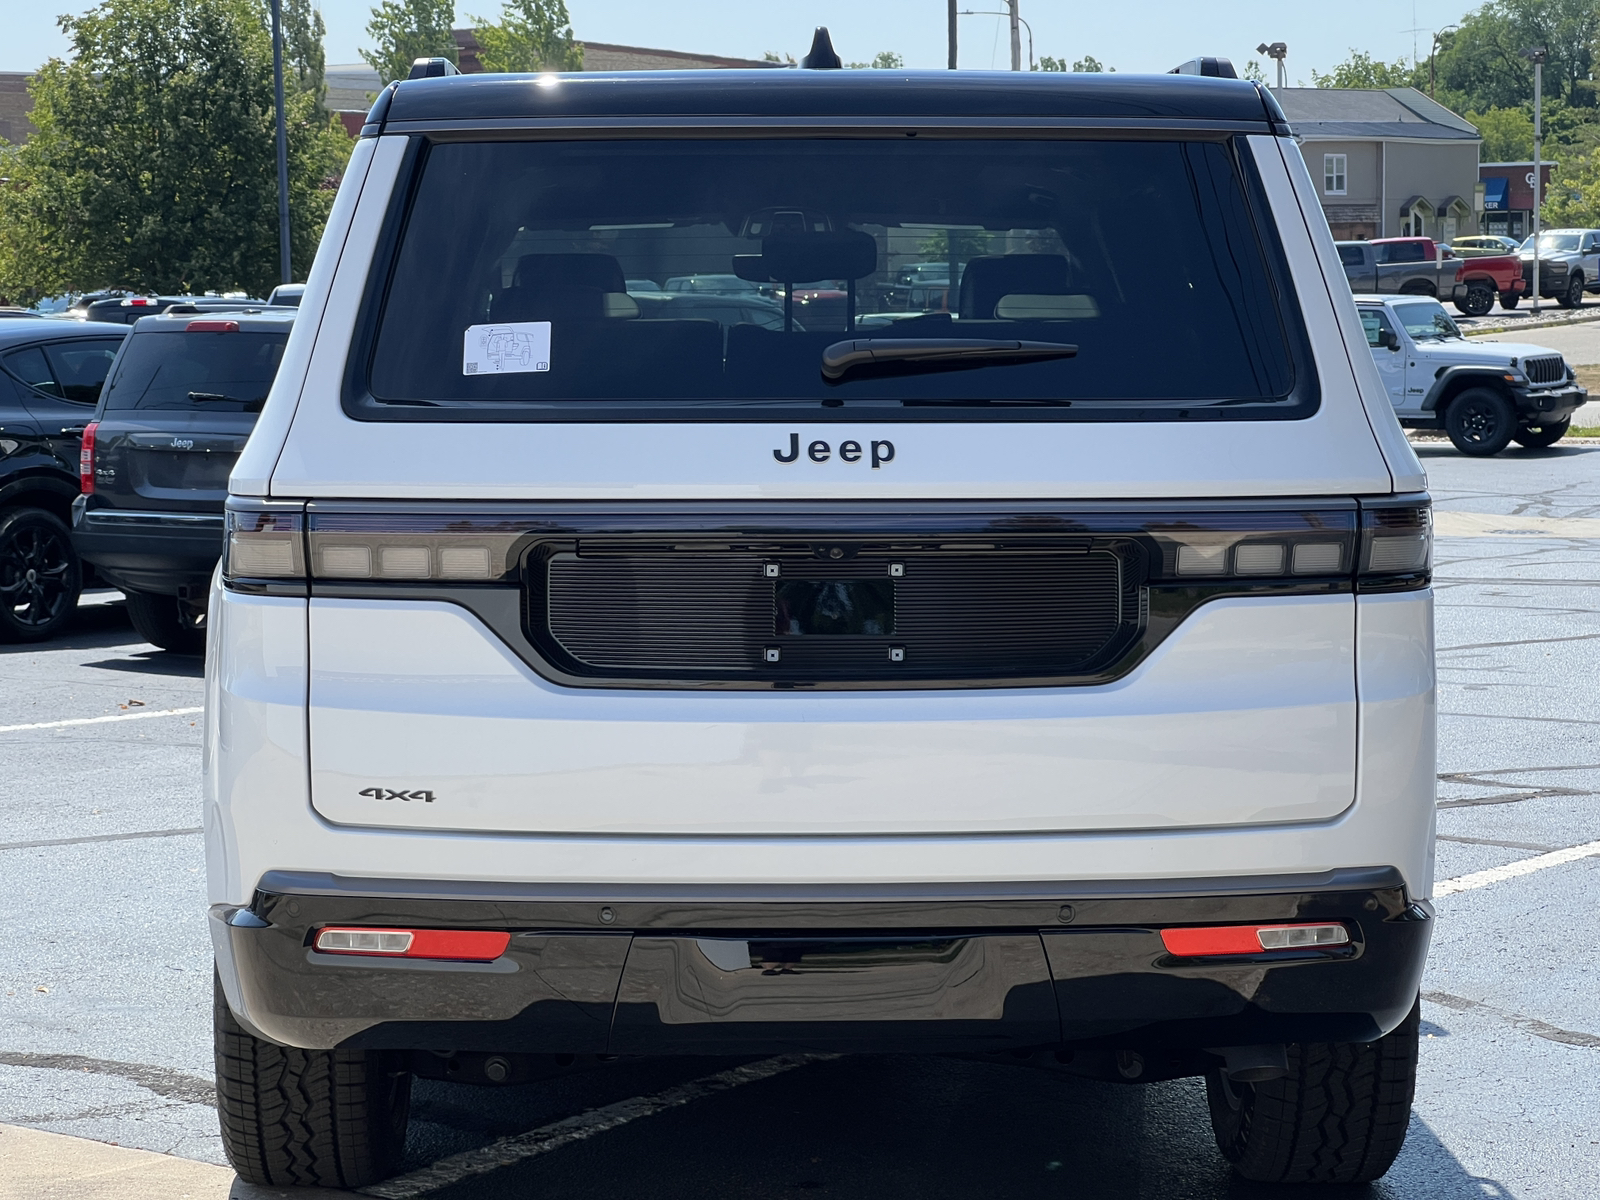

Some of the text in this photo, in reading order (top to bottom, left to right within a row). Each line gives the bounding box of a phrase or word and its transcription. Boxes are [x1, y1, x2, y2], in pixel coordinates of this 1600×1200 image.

[1407, 386, 1424, 394] Jeep
[170, 437, 194, 450] Jeep
[773, 432, 896, 469] Jeep
[358, 787, 437, 803] 4x4
